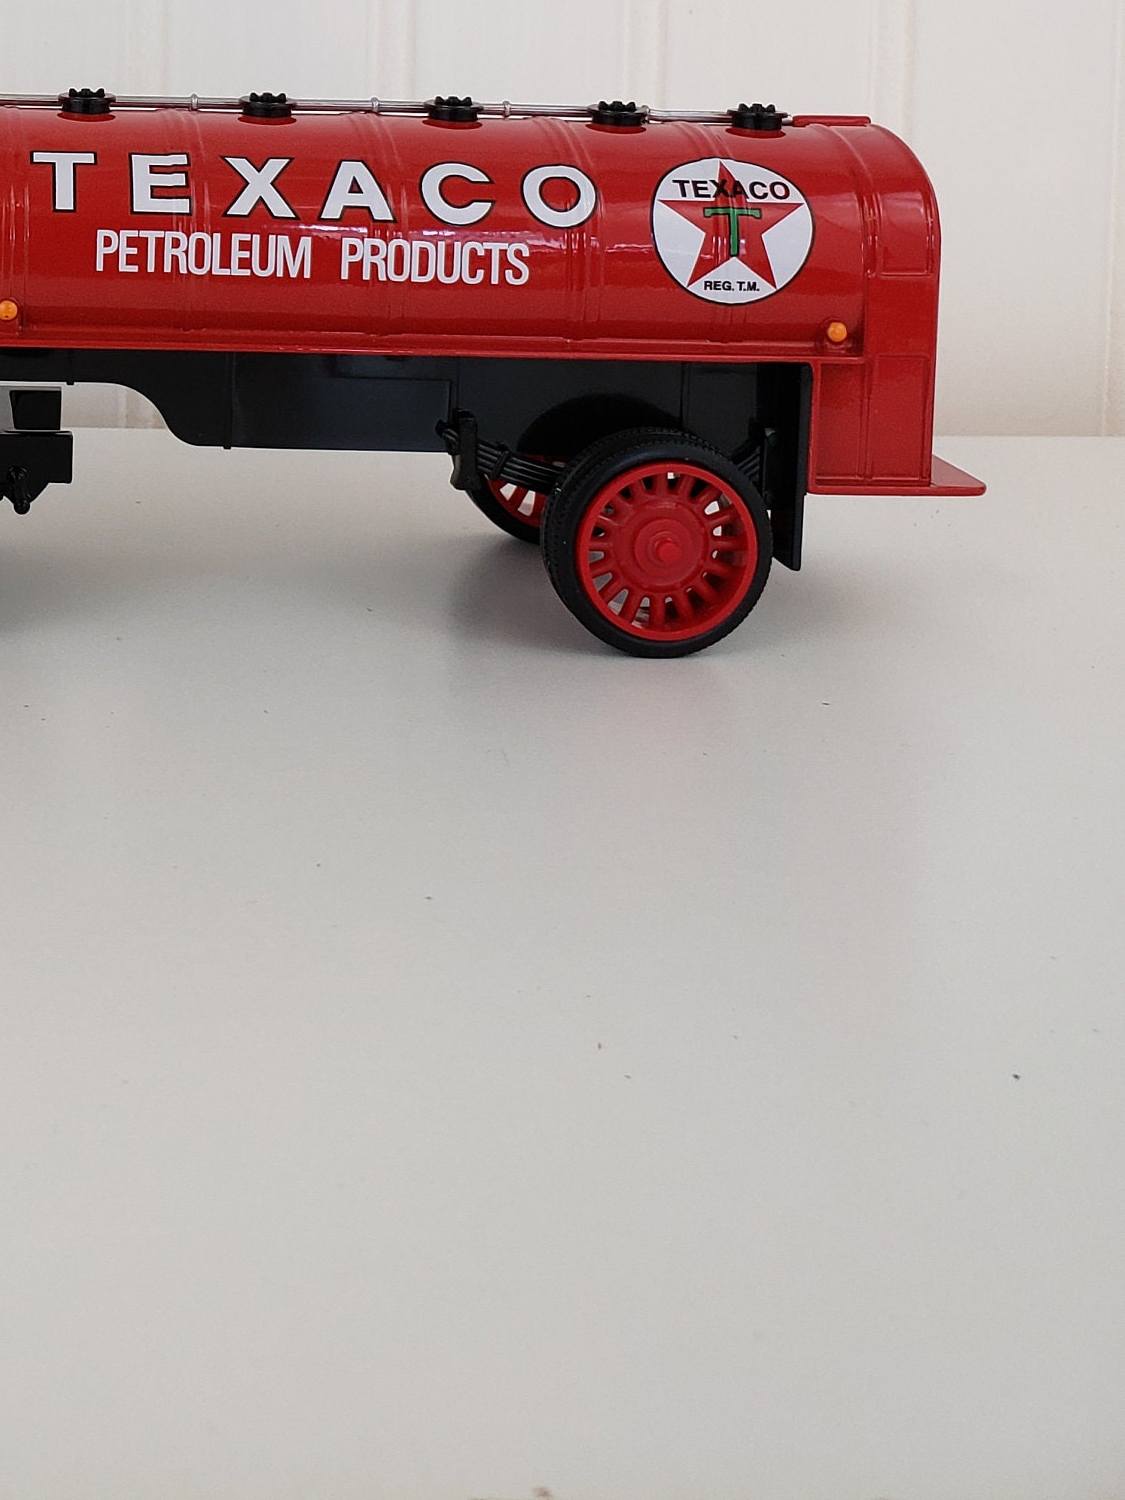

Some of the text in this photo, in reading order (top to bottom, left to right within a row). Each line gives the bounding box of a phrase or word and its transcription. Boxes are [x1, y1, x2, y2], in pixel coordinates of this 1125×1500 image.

[30, 151, 598, 228] TEXACO
[672, 179, 791, 200] TEXACO
[703, 207, 762, 257] T
[95, 229, 530, 286] PETROLEUM PRODUCTS
[704, 280, 760, 291] REG. T.M.
